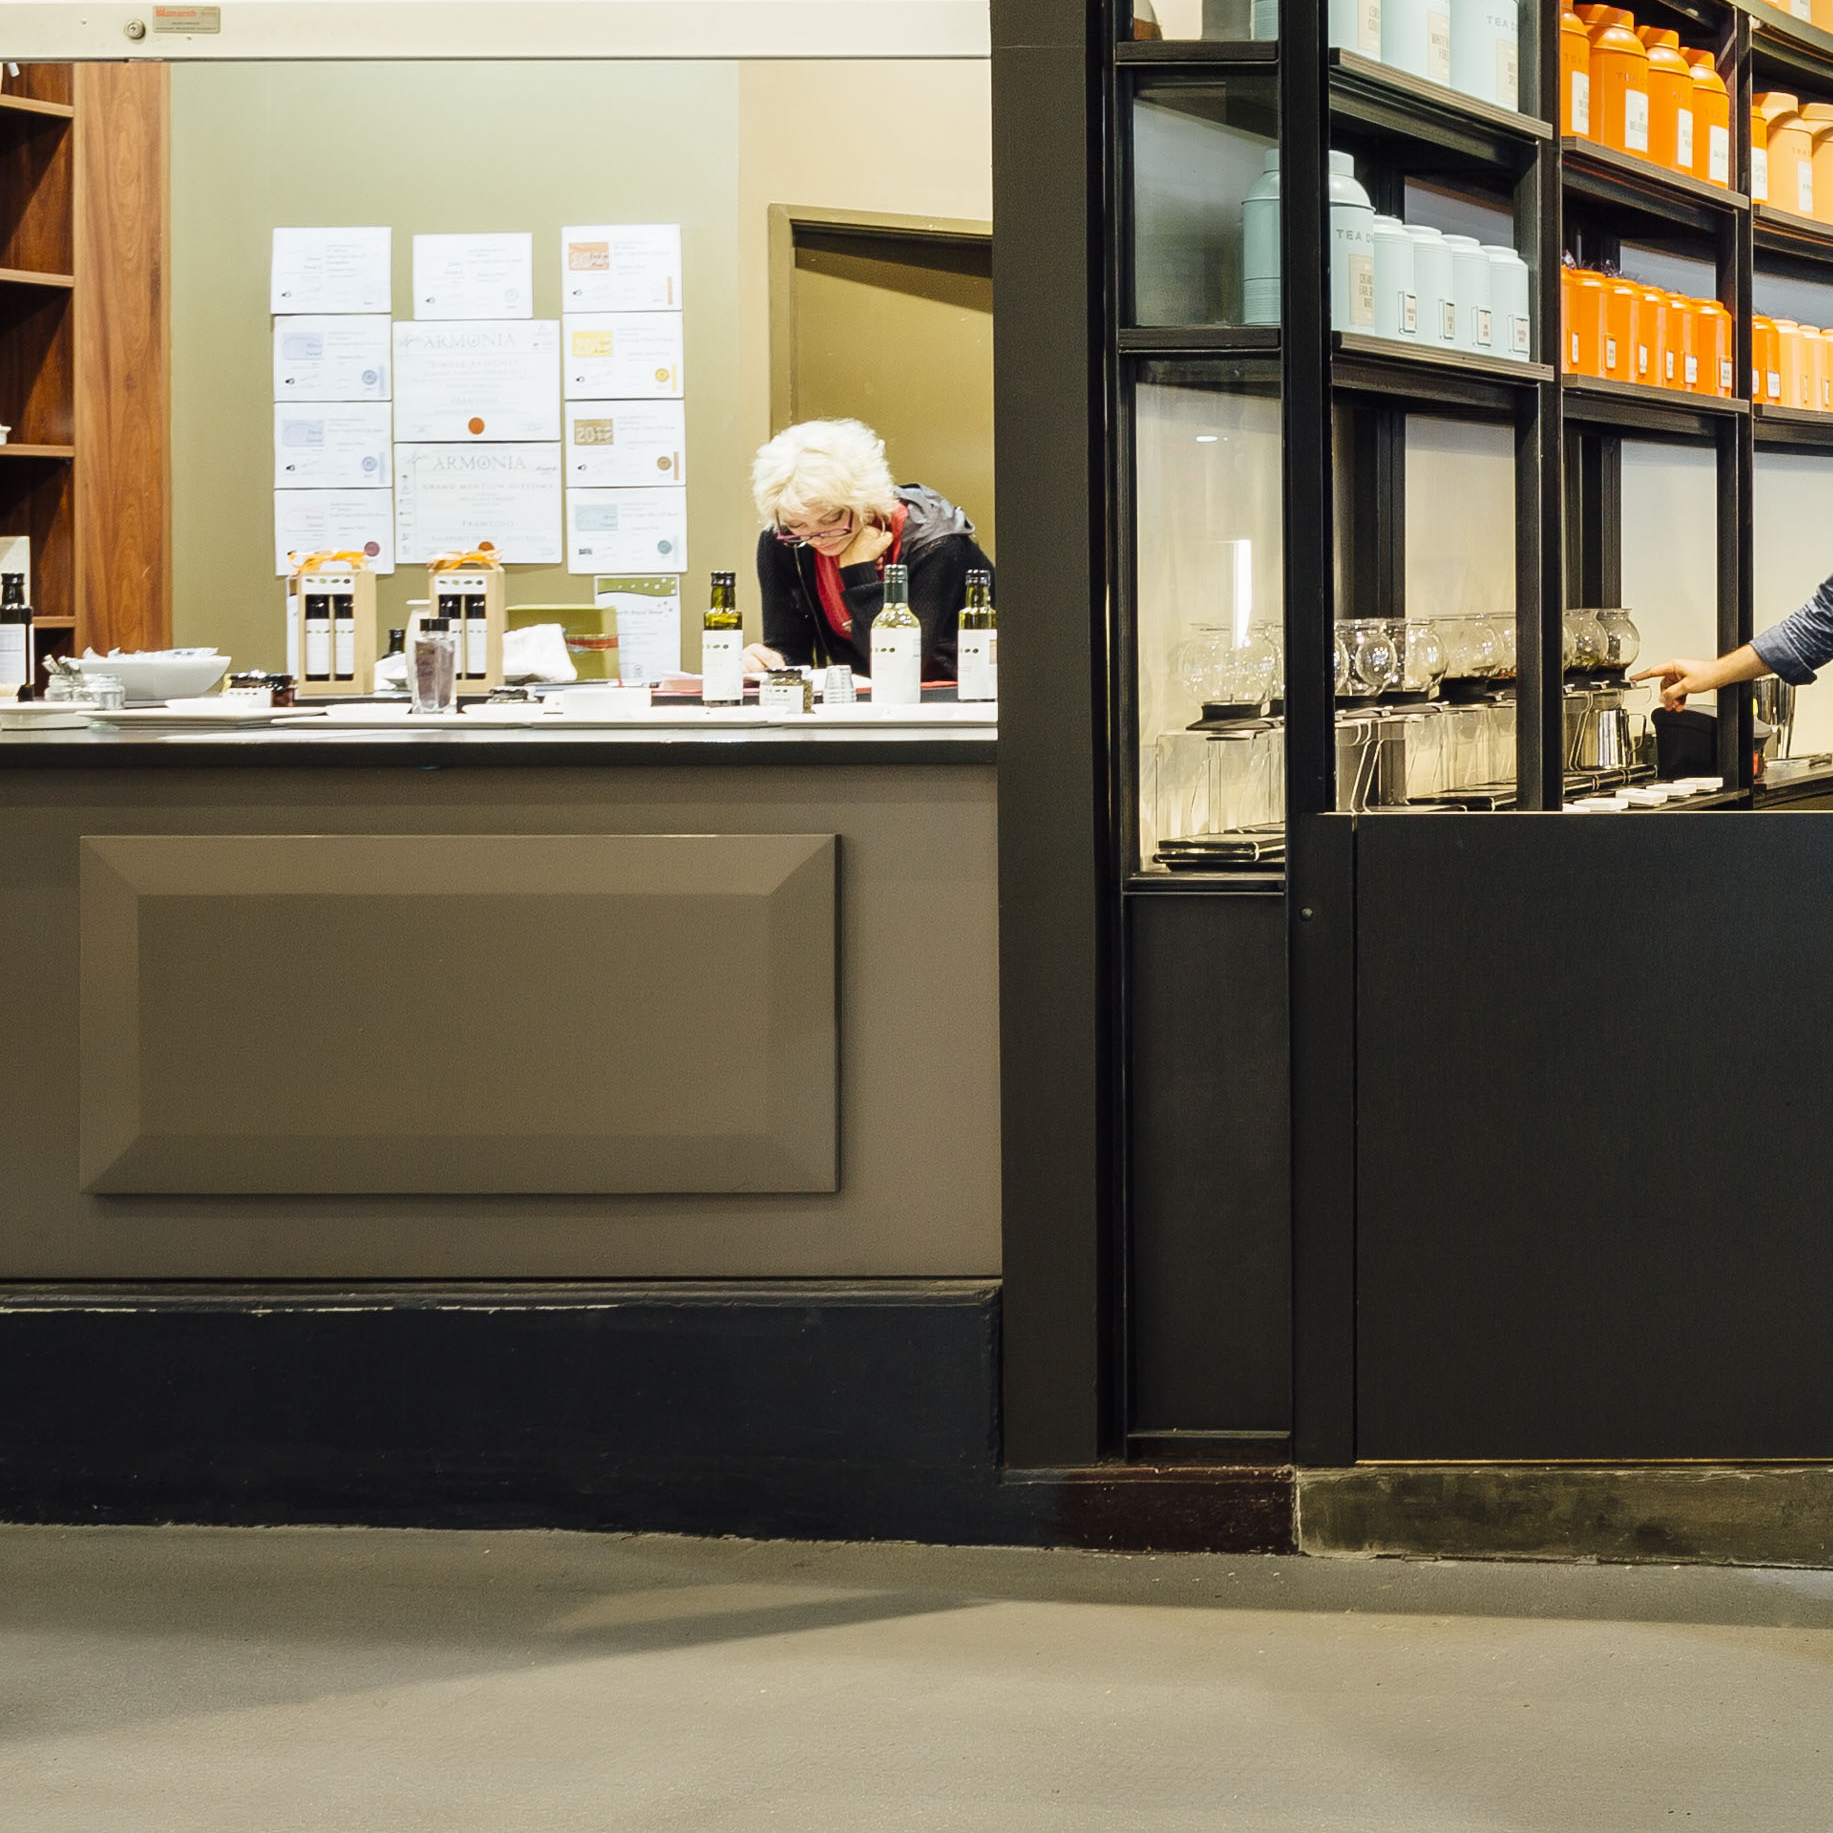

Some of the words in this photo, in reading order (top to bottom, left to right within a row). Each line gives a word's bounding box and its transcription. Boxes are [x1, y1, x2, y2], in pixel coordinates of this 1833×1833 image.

[1486, 15, 1509, 28] TEA
[1336, 229, 1362, 241] TEA
[423, 330, 516, 350] ARMONIA
[432, 455, 527, 471] ARMONIA
